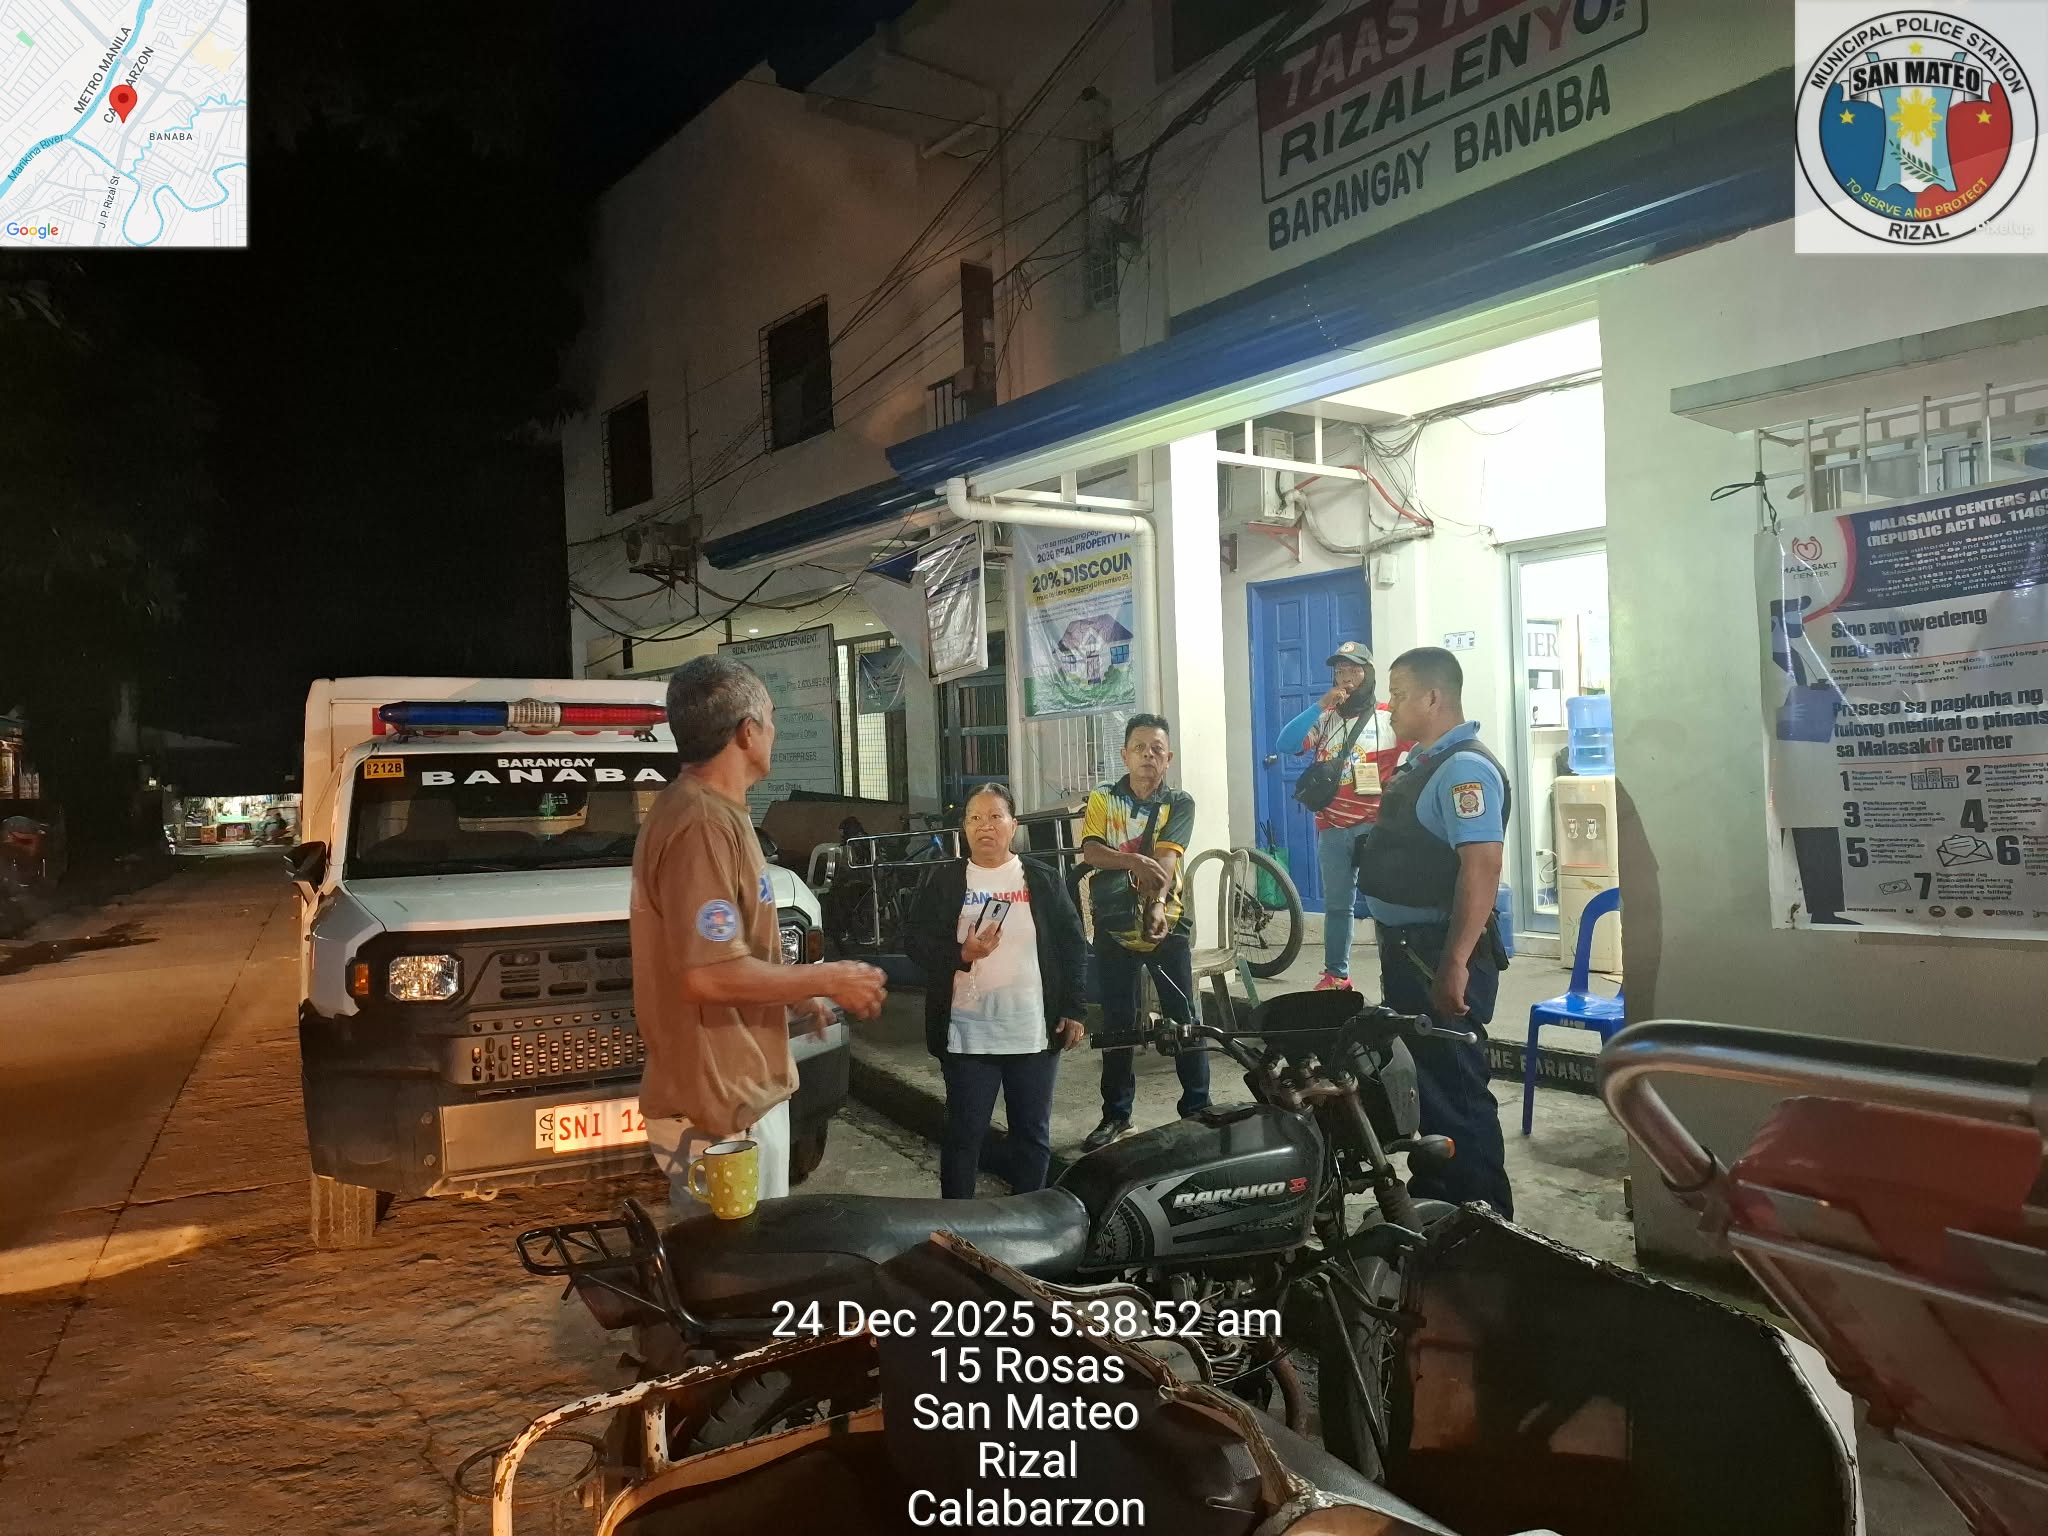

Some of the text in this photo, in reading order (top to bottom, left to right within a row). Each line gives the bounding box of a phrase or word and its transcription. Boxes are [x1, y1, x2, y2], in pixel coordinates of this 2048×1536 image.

[1282, 0, 1419, 108] TAAS
[1268, 63, 1611, 251] BARANGAY BANABA
[1869, 507, 1952, 532] MALASAKIT
[1955, 493, 2027, 517] CENTERS
[1075, 533, 1116, 552] PROPERTY
[1866, 525, 1942, 547] (REPUBLIC
[1945, 518, 1976, 534] ACT
[1979, 513, 2006, 528] NO.
[1032, 551, 1132, 593] 20% DISCOUN
[1832, 608, 1988, 638] Sino ang pwedeng
[1904, 701, 1927, 714] sa
[1931, 691, 2013, 714] pagkuha
[2017, 688, 2043, 705] ng
[1888, 715, 1962, 735] medikal
[1966, 716, 1979, 729] o
[1836, 735, 2013, 758] sa Malasakit Center
[373, 762, 402, 775] 212B
[497, 758, 596, 768] BARANGAY
[1966, 766, 1982, 785] 2
[421, 768, 667, 786] BANABA
[1455, 784, 1480, 793] RIZAL
[1840, 771, 1850, 791] 1
[1843, 802, 1861, 827] 3
[1960, 799, 1988, 833] 4
[1846, 837, 1869, 867] 5
[1996, 835, 2021, 865] 6
[1914, 873, 1932, 899] 7
[559, 1113, 602, 1140] SNI
[1173, 1182, 1286, 1208] BARAKO
